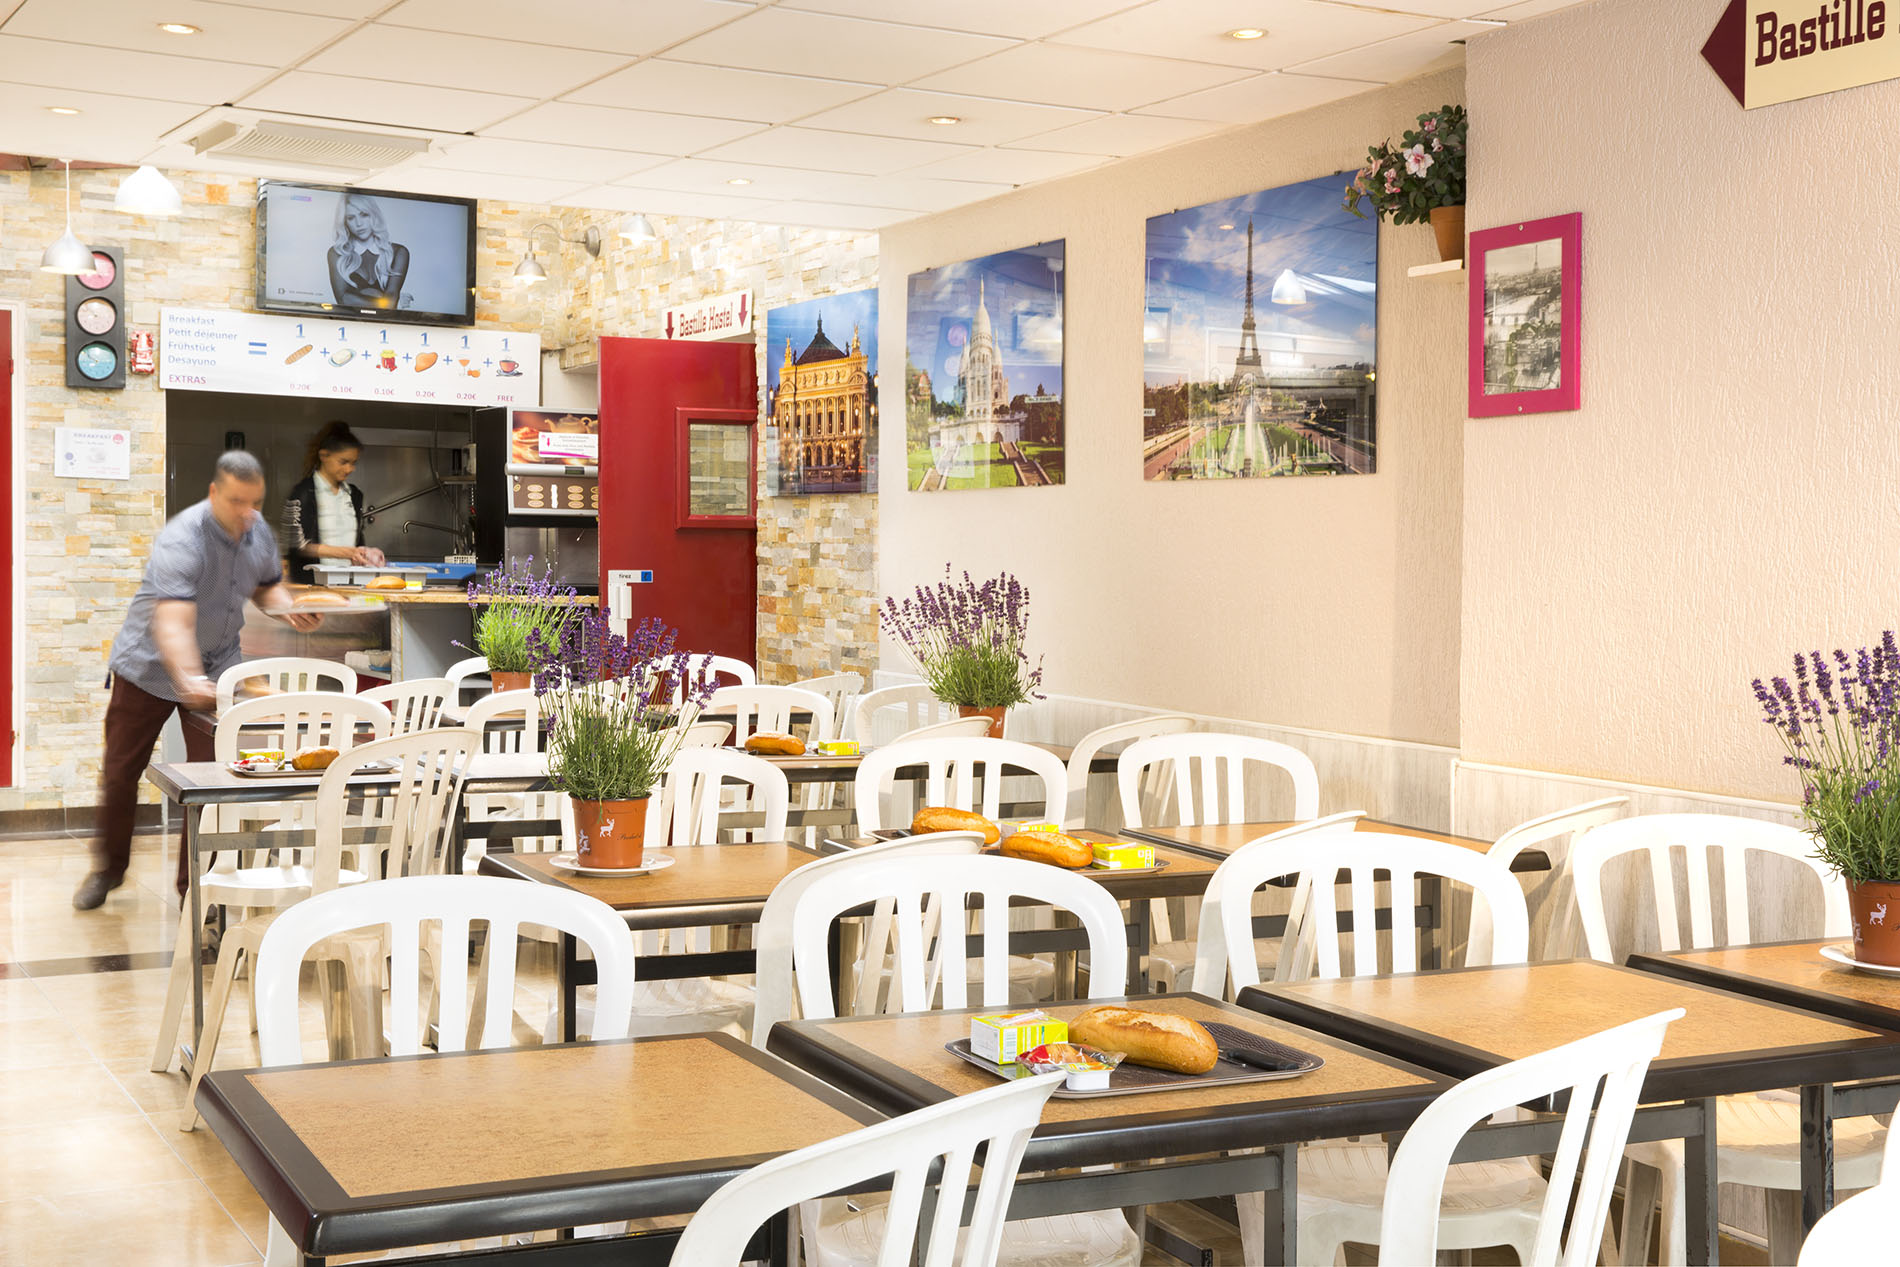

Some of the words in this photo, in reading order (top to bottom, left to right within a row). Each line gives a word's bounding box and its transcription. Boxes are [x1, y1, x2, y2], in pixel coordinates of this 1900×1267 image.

[1755, 0, 1886, 67] Bastille
[168, 314, 215, 326] Breakfast
[168, 327, 192, 337] Petit
[679, 308, 706, 337] Bastille
[708, 301, 733, 331] Hostel
[296, 324, 305, 338] 1
[338, 327, 347, 341] 1
[380, 329, 389, 344] 1
[420, 332, 430, 347] 1
[461, 335, 470, 349] 1
[502, 338, 510, 352] 1
[168, 355, 216, 367] Desayuno
[168, 374, 207, 385] EXTRAS
[332, 386, 353, 394] 0.10€
[416, 391, 436, 399] 0.20€
[457, 393, 477, 401] 0.20€
[497, 395, 514, 403] FREE
